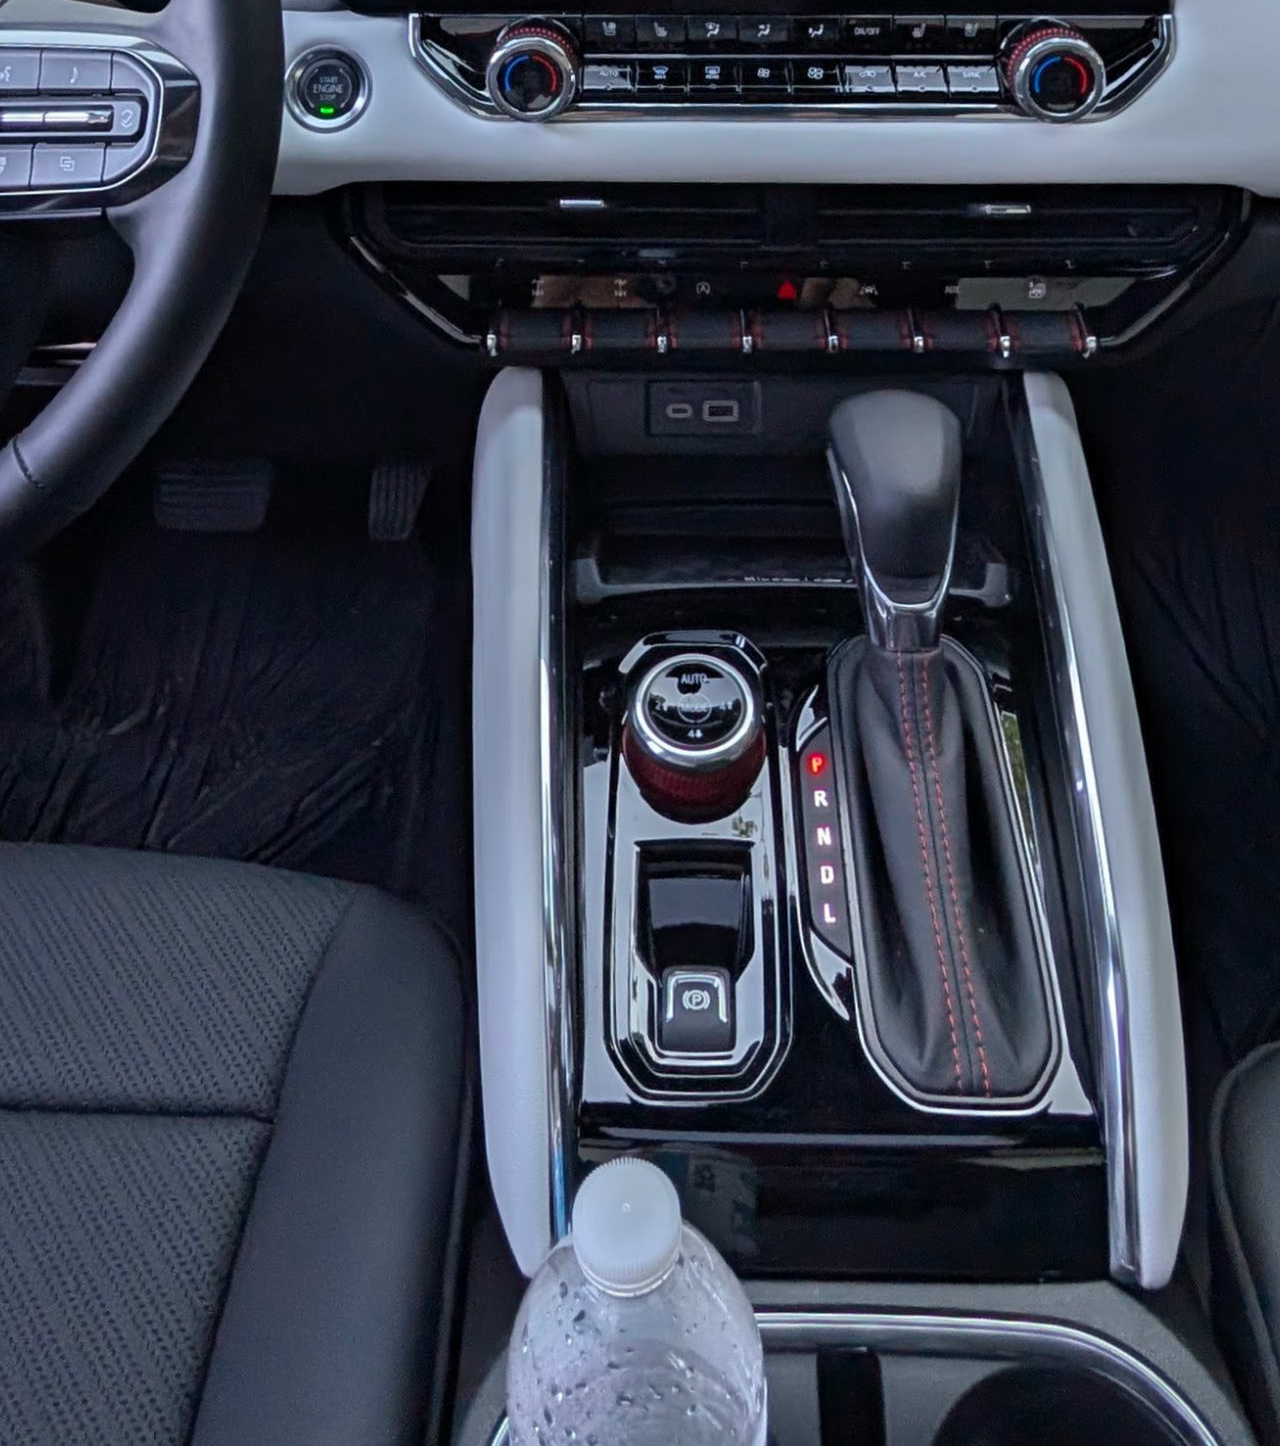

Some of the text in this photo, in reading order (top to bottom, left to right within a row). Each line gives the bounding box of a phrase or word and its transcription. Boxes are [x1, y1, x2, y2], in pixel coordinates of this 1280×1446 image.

[854, 27, 880, 35] ON/OFF
[599, 69, 618, 77] AUTO
[313, 84, 343, 93] ENGINE
[811, 757, 823, 772] P
[813, 790, 829, 807] R
[816, 827, 832, 845] N
[820, 865, 834, 885] D
[823, 903, 836, 923] L
